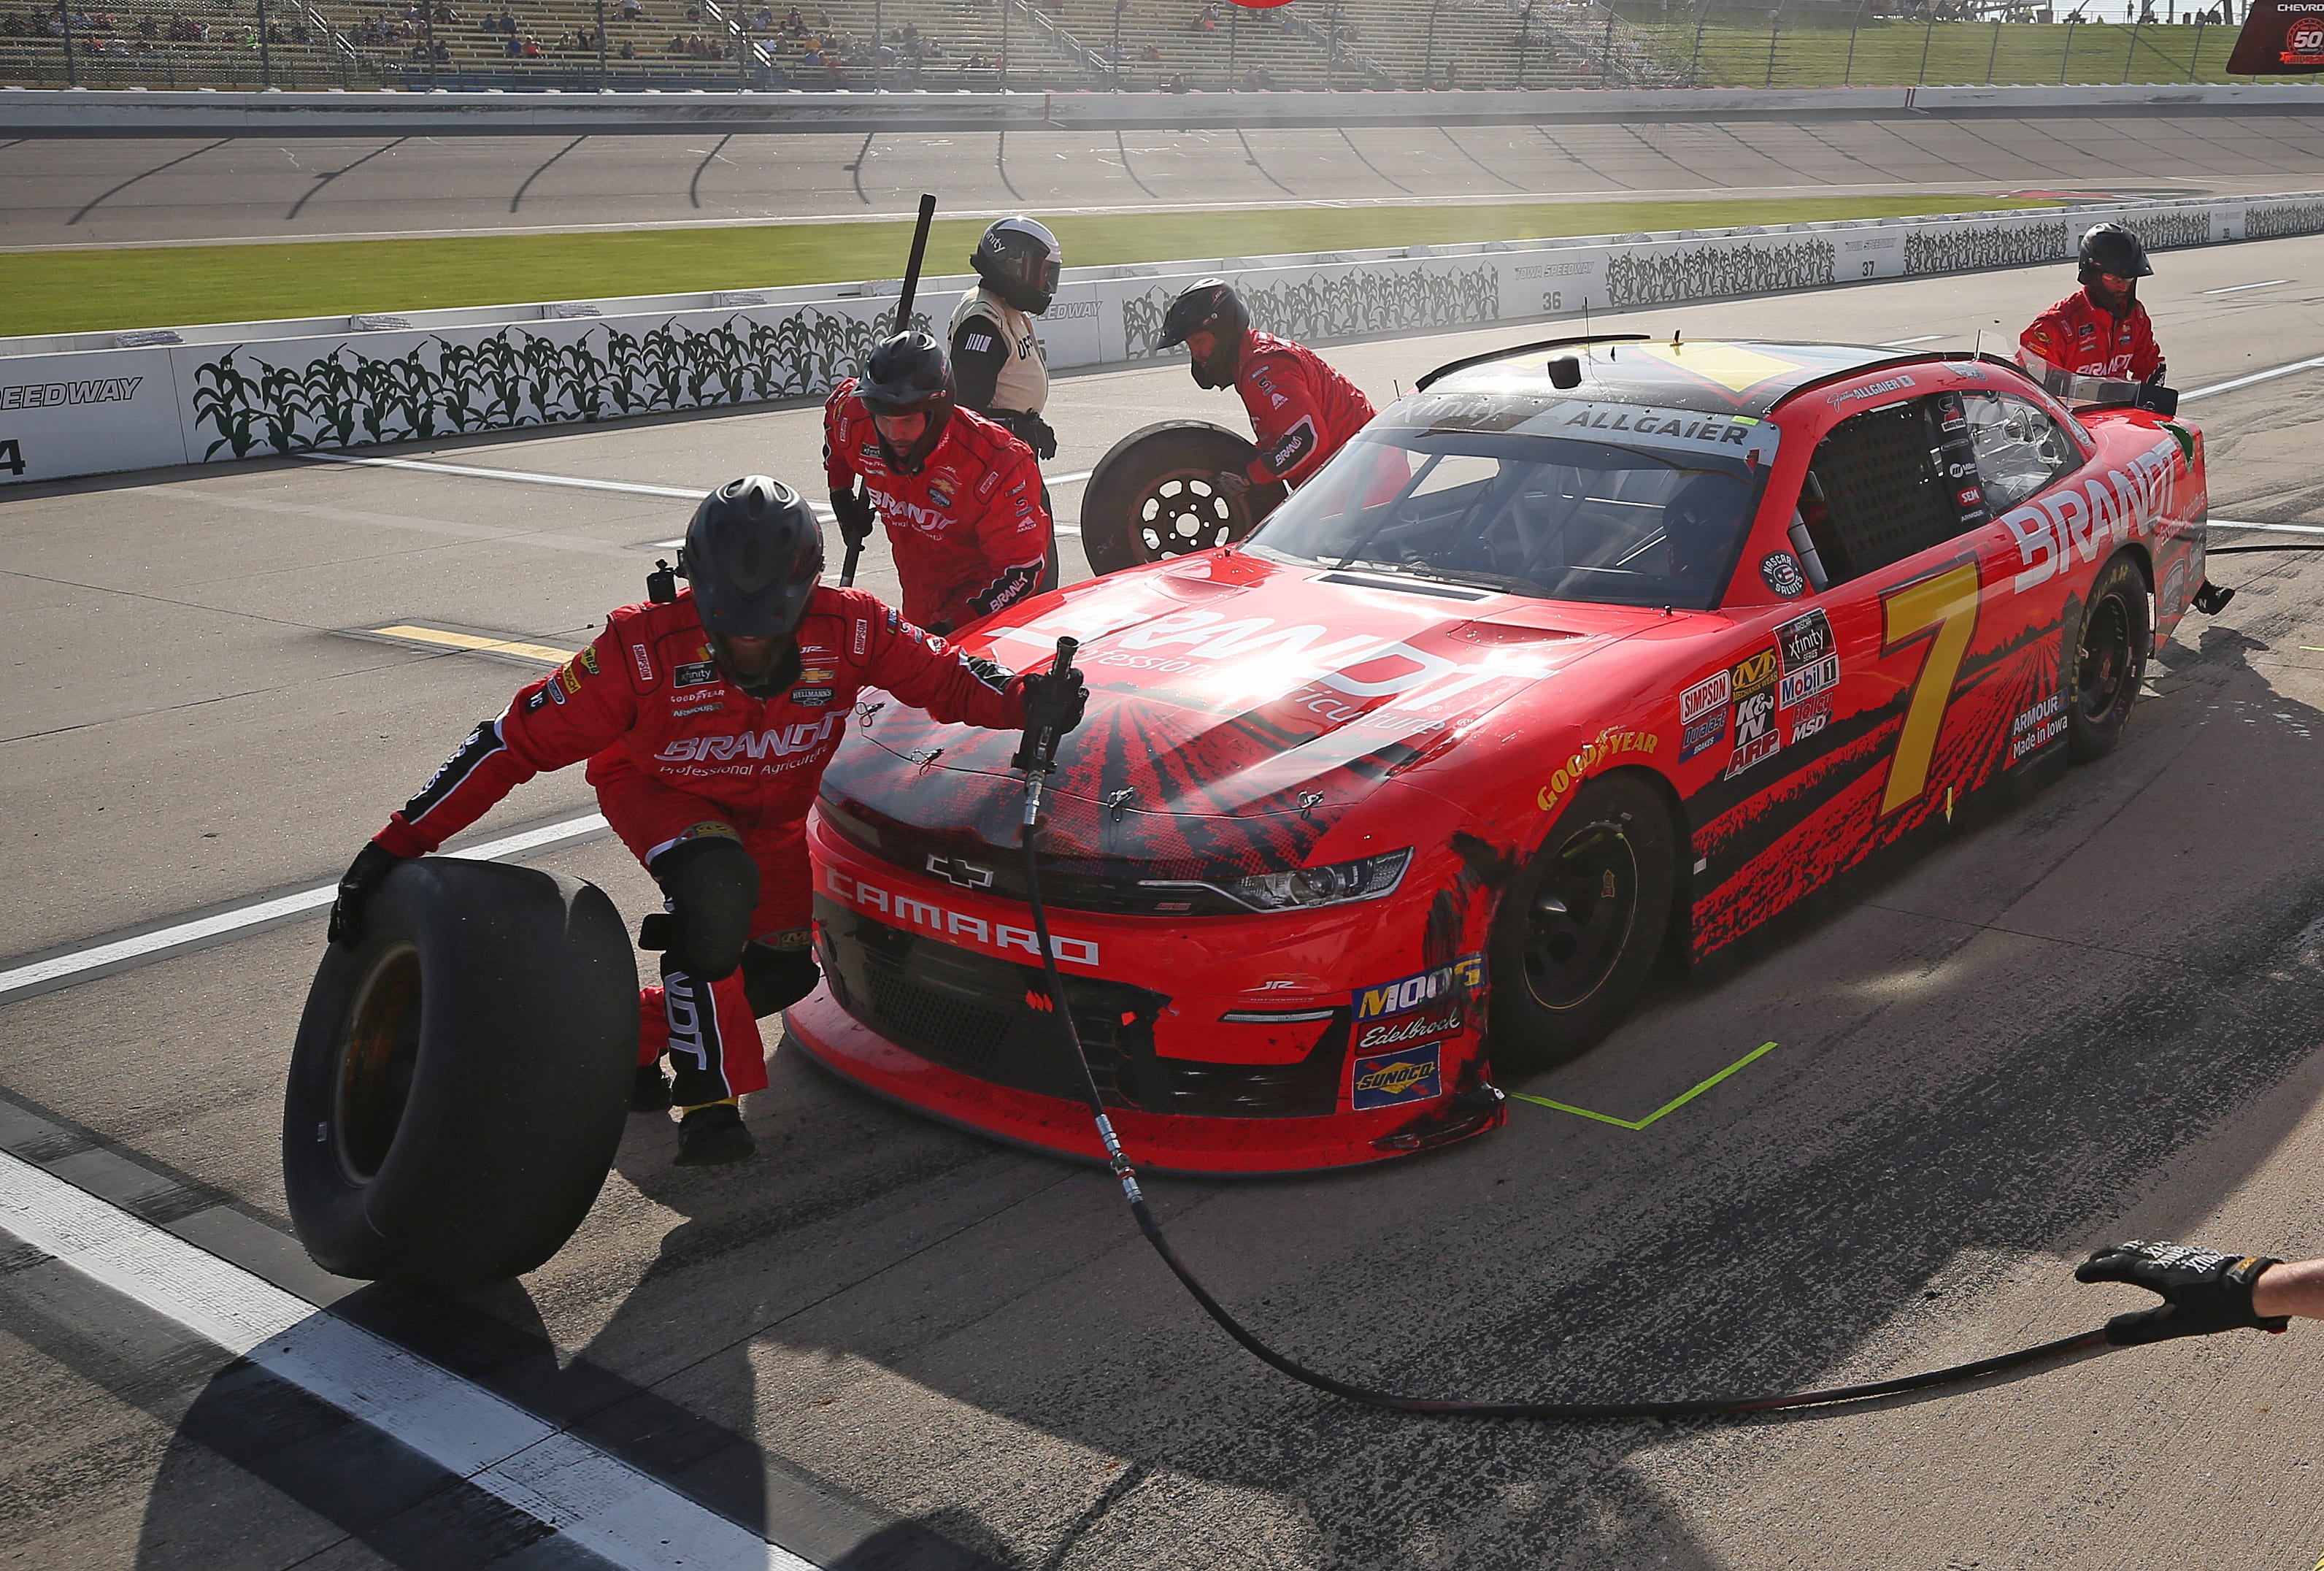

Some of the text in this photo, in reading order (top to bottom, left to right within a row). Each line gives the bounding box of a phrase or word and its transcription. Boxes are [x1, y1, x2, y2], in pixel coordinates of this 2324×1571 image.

[2293, 31, 2323, 48] 50
[1544, 261, 1595, 277] SPEEDWAY
[1863, 261, 1874, 277] 37
[1542, 291, 1561, 310] 36
[0, 377, 143, 410] EEDWAY
[1853, 379, 1900, 400] ALLGAIER
[1565, 410, 1748, 446] ALLGAIER
[866, 485, 958, 531] BRANDT
[1961, 490, 1980, 502] SEM
[2000, 437, 2178, 595] BRANDT
[1763, 554, 1792, 575] NASCAR
[1775, 575, 1803, 595] SALUTES
[855, 621, 867, 653] SIMPSON
[1789, 629, 1823, 660] xfinity
[633, 645, 652, 680] SIMPSON
[1804, 649, 1818, 662] SERIES
[680, 669, 712, 683] xfinity
[1782, 664, 1820, 703] Mobil
[1827, 661, 1836, 680] 1
[1879, 556, 1982, 818] 7
[1685, 676, 1725, 718] SIMPSON
[1793, 692, 1833, 728] Holley
[1683, 707, 1725, 748] Duralast
[1791, 715, 1827, 745] MSD
[2013, 695, 2058, 736] ARMOUR
[654, 707, 850, 761] BRANDT
[1693, 736, 1715, 755] BRAKES
[2013, 715, 2068, 759] Made in Iowa
[1728, 731, 1779, 775] ARP
[827, 867, 1099, 966] CAMARO
[1358, 958, 1482, 1019] MOOG
[1360, 1007, 1461, 1049] Edelbrock
[1358, 1061, 1436, 1090] SUNOCO
